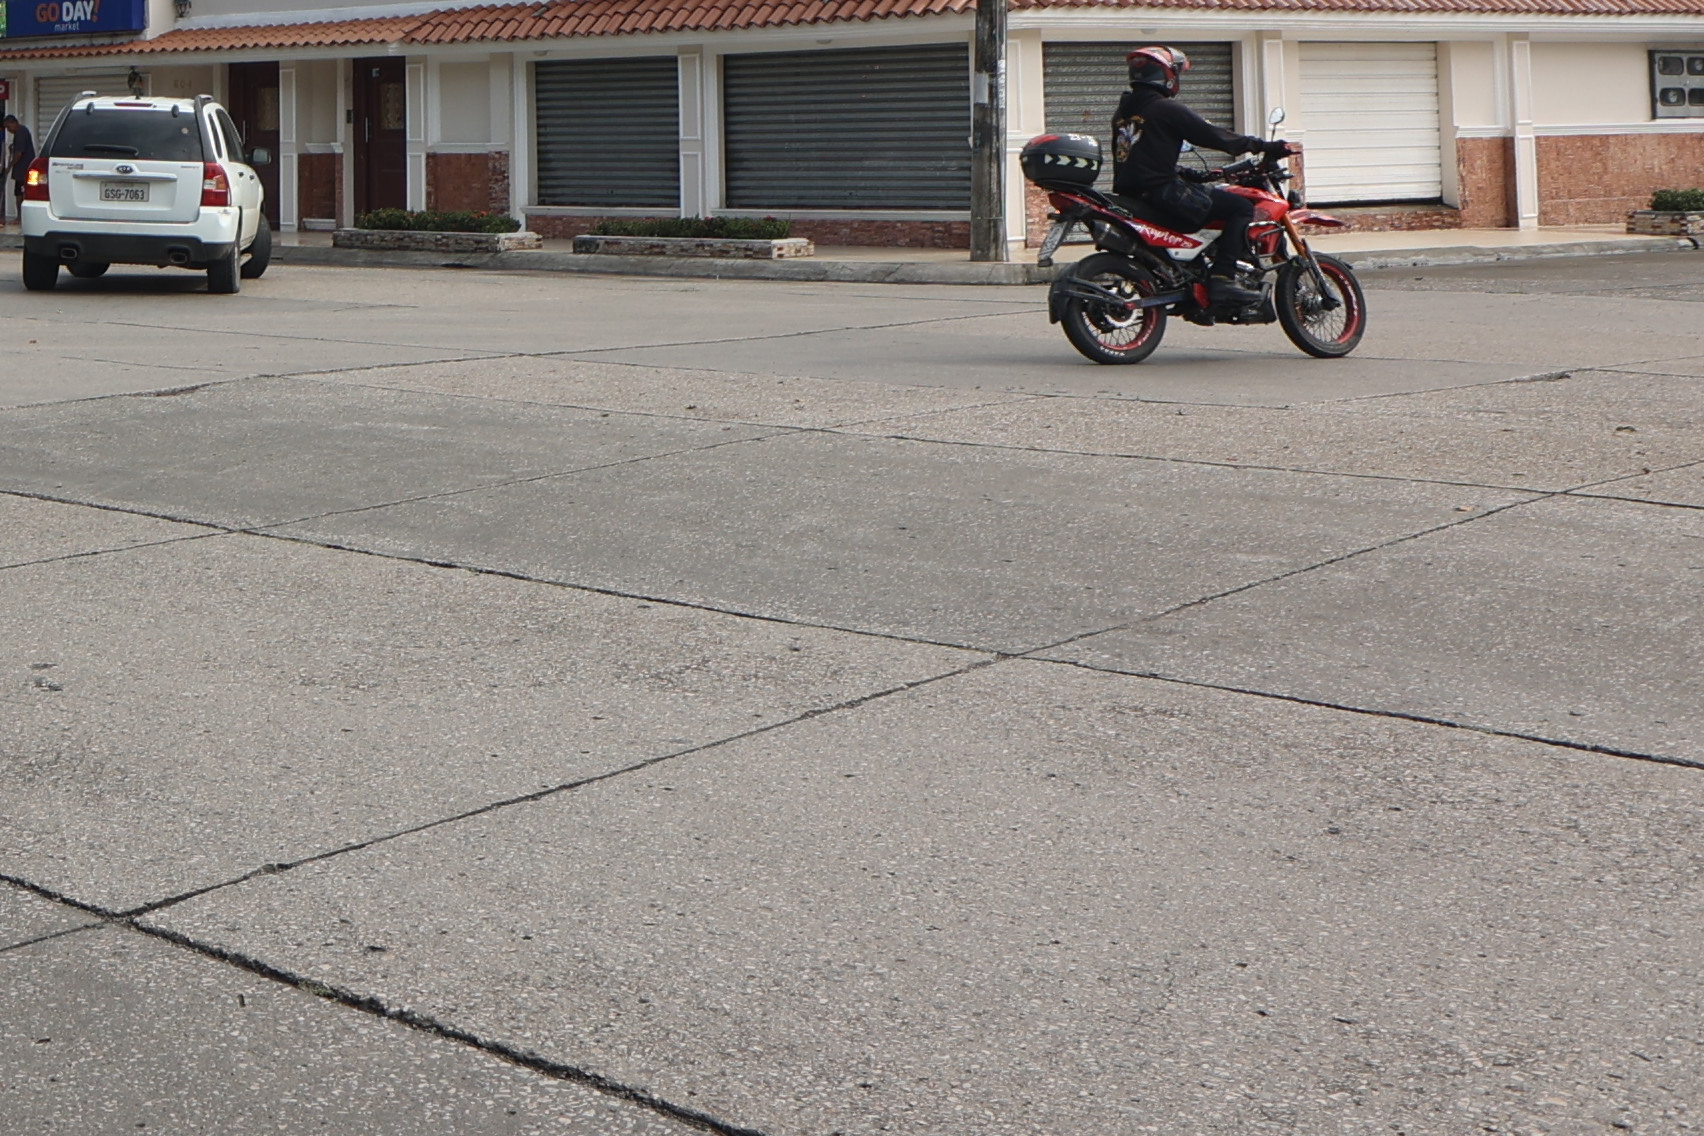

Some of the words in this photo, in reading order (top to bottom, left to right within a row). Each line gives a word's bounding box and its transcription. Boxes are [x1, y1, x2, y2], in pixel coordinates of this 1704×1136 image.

[36, 2, 60, 23] GO
[54, 22, 80, 32] market
[104, 187, 145, 200] GSG-7063
